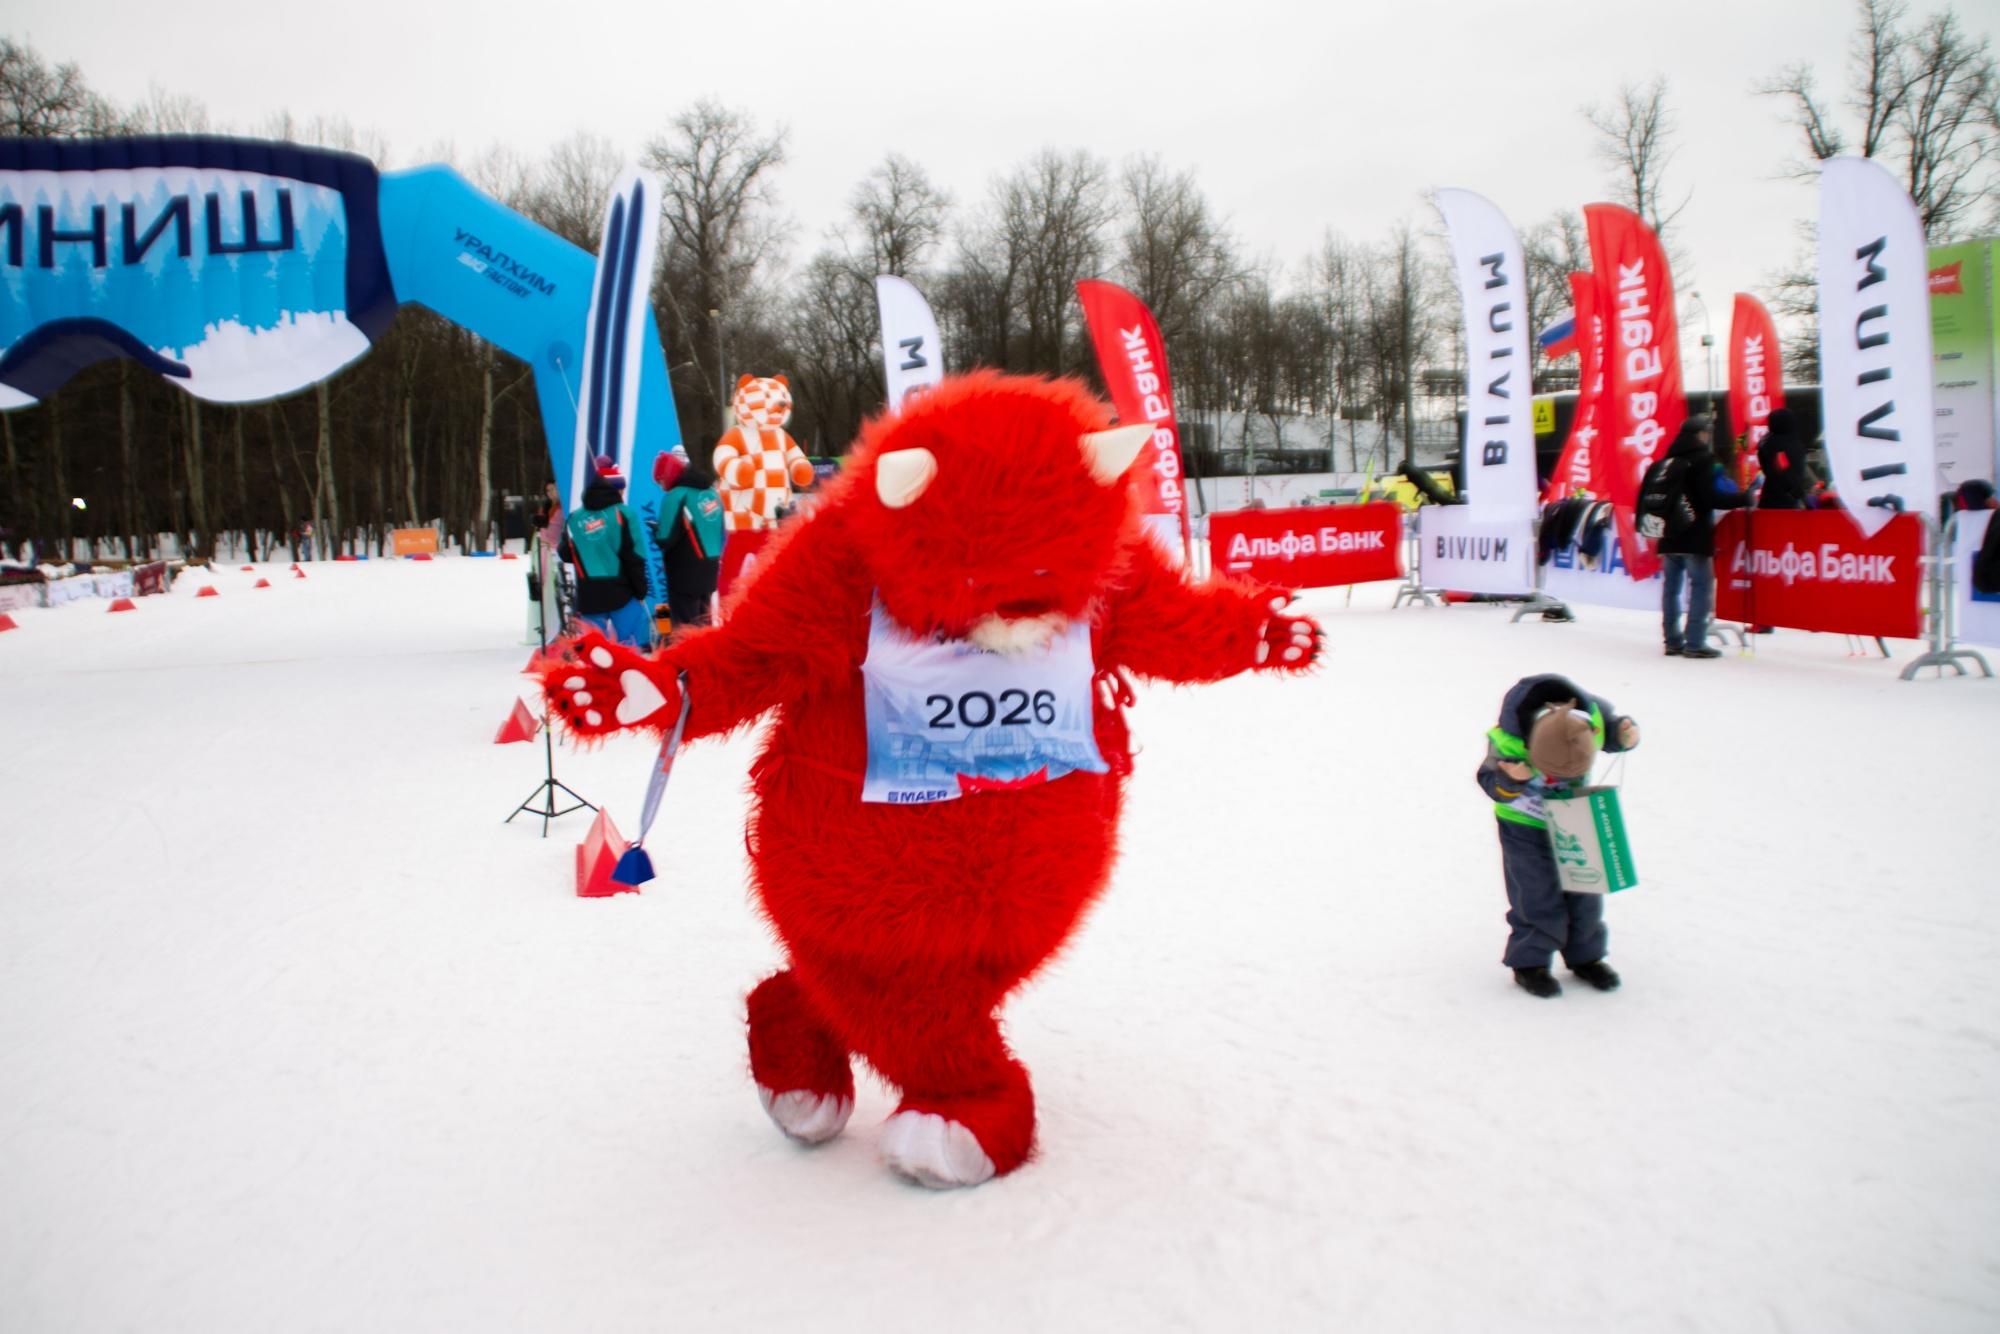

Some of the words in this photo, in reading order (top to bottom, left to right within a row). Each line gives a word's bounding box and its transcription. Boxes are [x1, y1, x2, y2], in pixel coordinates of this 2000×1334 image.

[455, 227, 556, 296] УРАЛХИМ
[1230, 529, 1317, 562] Альфа
[1321, 527, 1385, 553] Банк
[1436, 536, 1508, 562] BIVIUM
[1731, 540, 1816, 585] Альфа
[1820, 543, 1896, 584] Банк
[926, 689, 1056, 729] 2026
[901, 790, 947, 802] MAER
